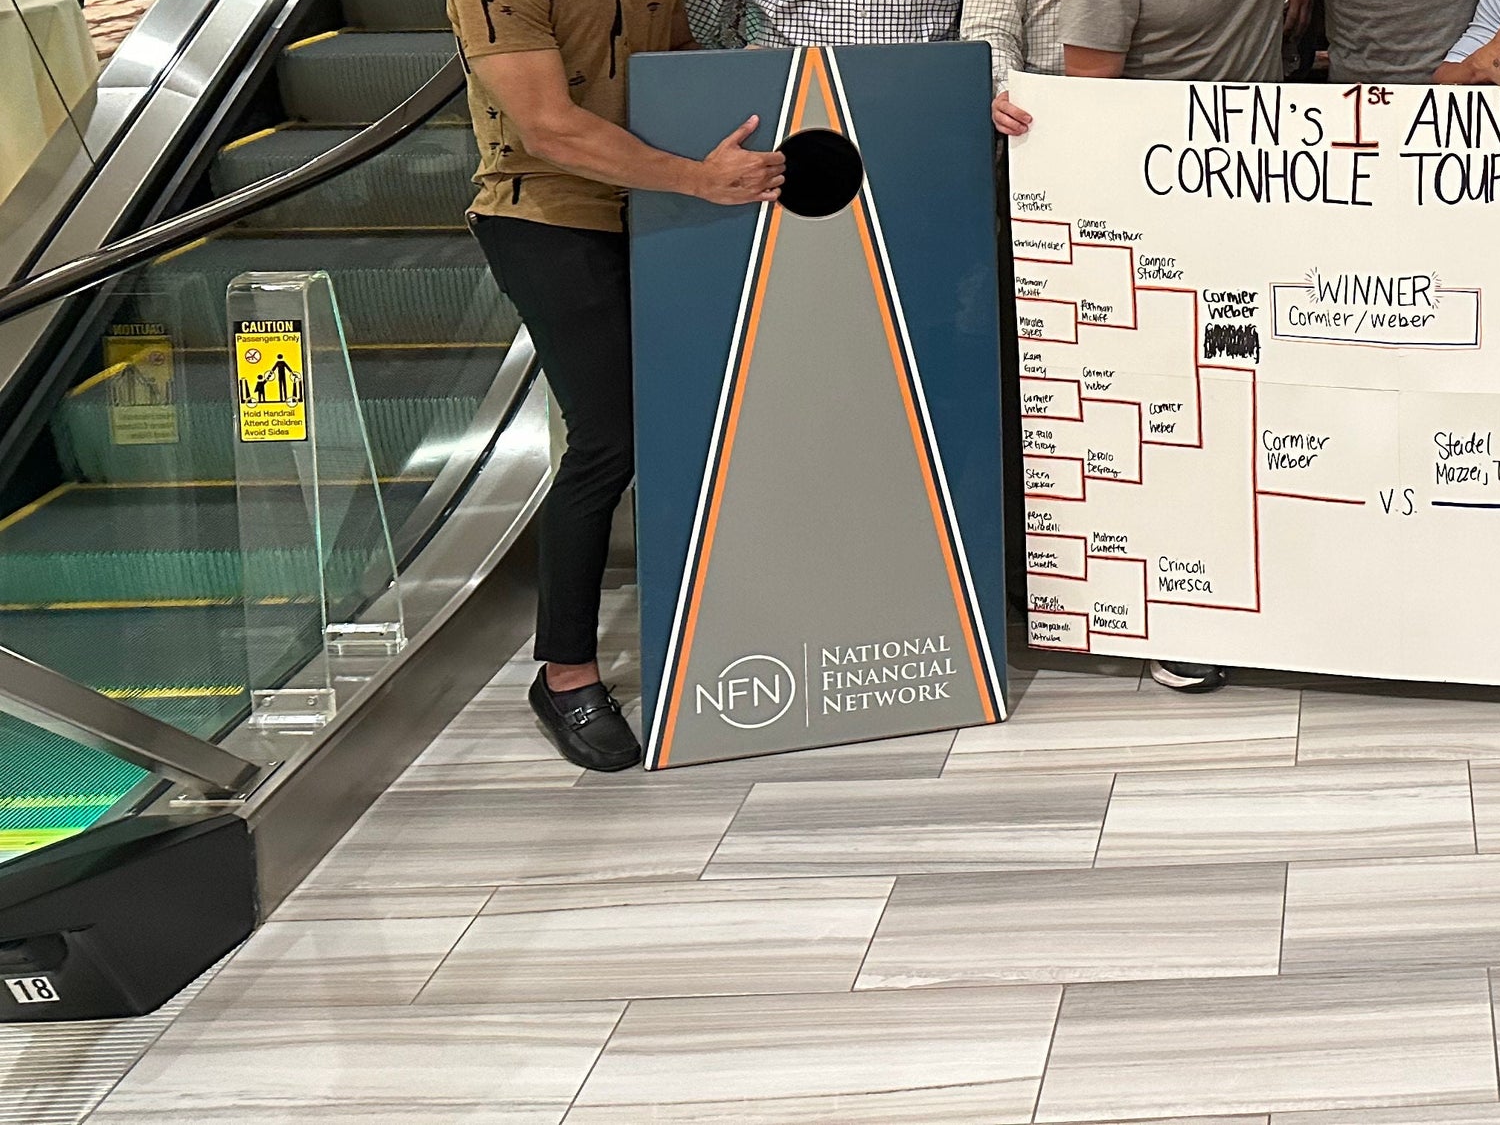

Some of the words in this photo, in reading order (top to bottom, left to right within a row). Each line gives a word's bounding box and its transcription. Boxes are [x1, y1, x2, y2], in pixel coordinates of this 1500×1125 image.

[1189, 85, 1323, 146] NFN's
[1145, 144, 1380, 206] CORNHOLE
[1139, 255, 1176, 267] Connors
[1137, 267, 1184, 280] Strothers
[1202, 288, 1259, 304] Cormier
[1317, 274, 1433, 307] WINNER
[242, 321, 294, 333] CAUTION
[237, 335, 281, 344] Passengers
[283, 335, 299, 343] Only
[243, 410, 261, 418] Hold
[244, 419, 269, 427] Attend
[244, 428, 266, 436] Avoid
[268, 428, 290, 436] Sides
[1262, 429, 1330, 452] Cormier
[1434, 431, 1492, 460] Steidel
[1267, 452, 1318, 470] Weber
[1435, 463, 1488, 485] Mazzei,
[1158, 556, 1206, 575] Crincoli
[1159, 576, 1213, 594] Maresca
[1094, 601, 1129, 616] Crincoli
[1093, 616, 1128, 630] Maresca
[821, 635, 951, 668] NATIONAL
[823, 658, 957, 691] FINANCIAL
[696, 674, 780, 714] NFN
[822, 682, 951, 715] NETWORK
[14, 978, 53, 1001] 18
